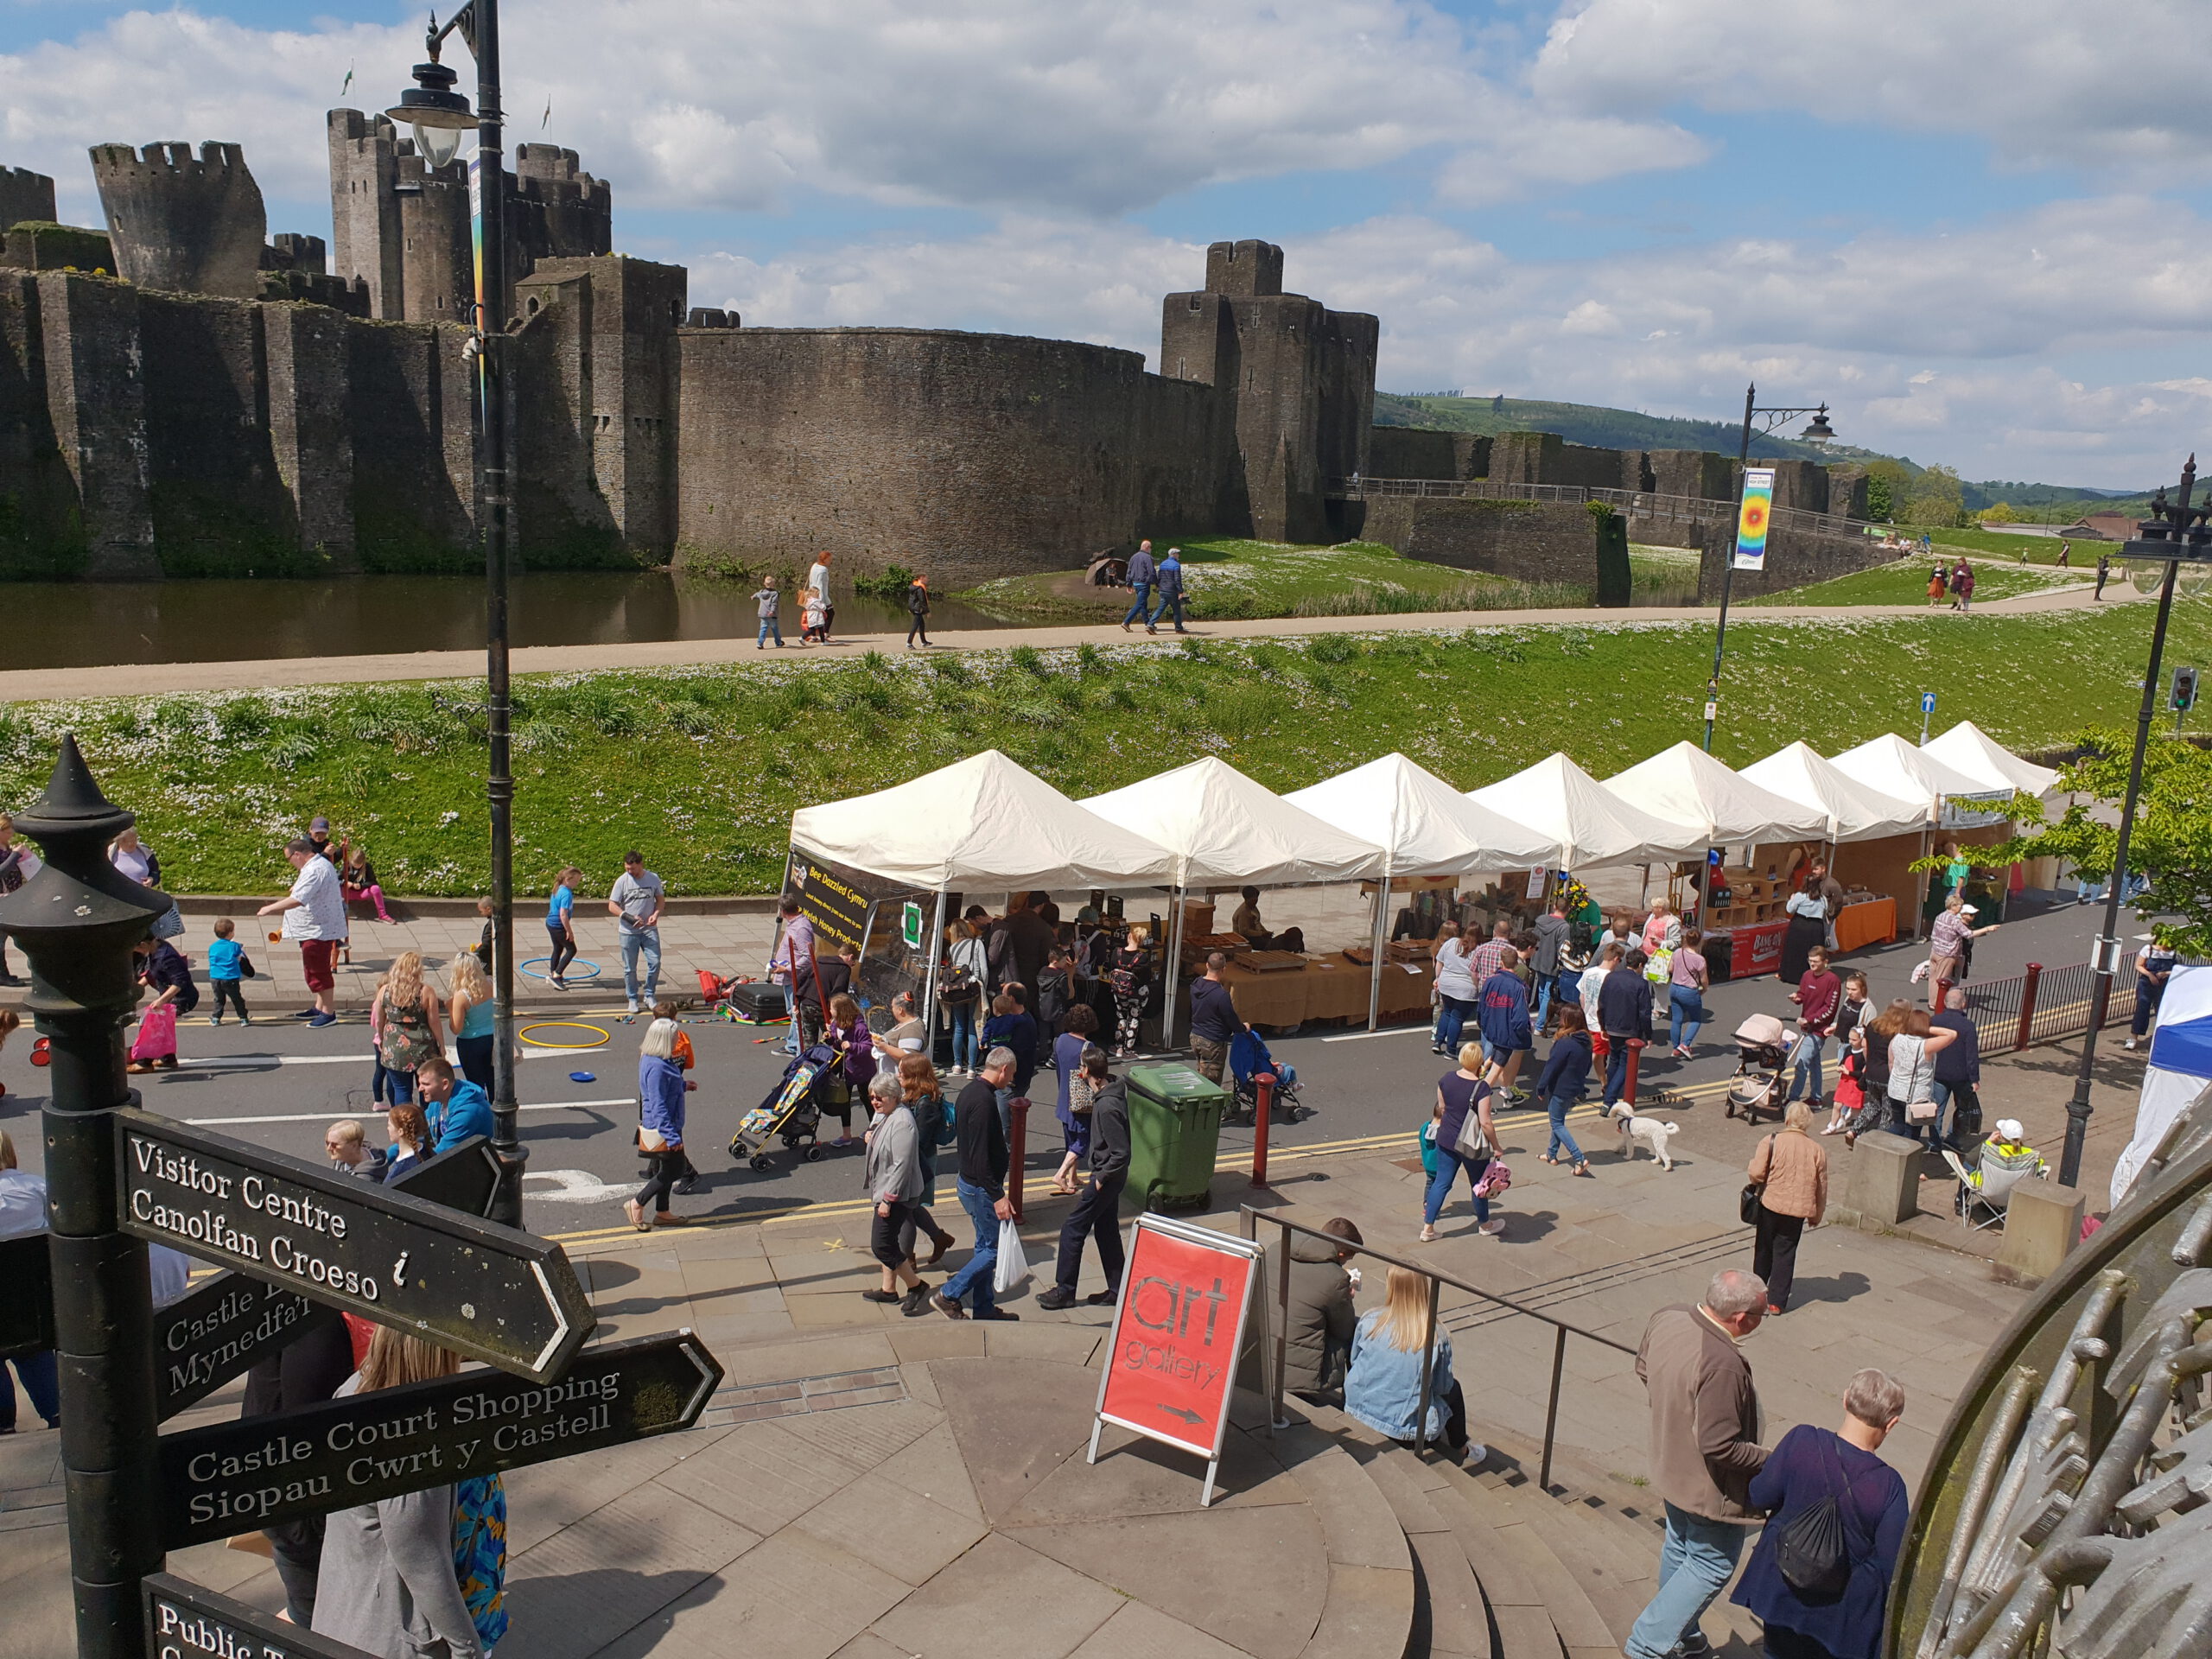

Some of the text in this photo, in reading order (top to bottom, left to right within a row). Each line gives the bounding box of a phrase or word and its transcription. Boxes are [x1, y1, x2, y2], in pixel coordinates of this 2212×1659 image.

[810, 867, 868, 909] Bee Dazzled Cymru
[814, 896, 823, 906] honey
[803, 907, 817, 924] Welsh
[818, 918, 836, 938] Honey
[131, 1137, 347, 1239] Visitor Centre
[132, 1189, 378, 1301] Canolfan Croeso
[167, 1292, 253, 1351] Castle
[1130, 1275, 1228, 1347] art
[1124, 1340, 1221, 1390] gallery
[188, 1370, 620, 1483] Castle Court Shopping
[189, 1404, 611, 1525] Siopau Cwrt y Castell
[158, 1603, 251, 1659] Public
